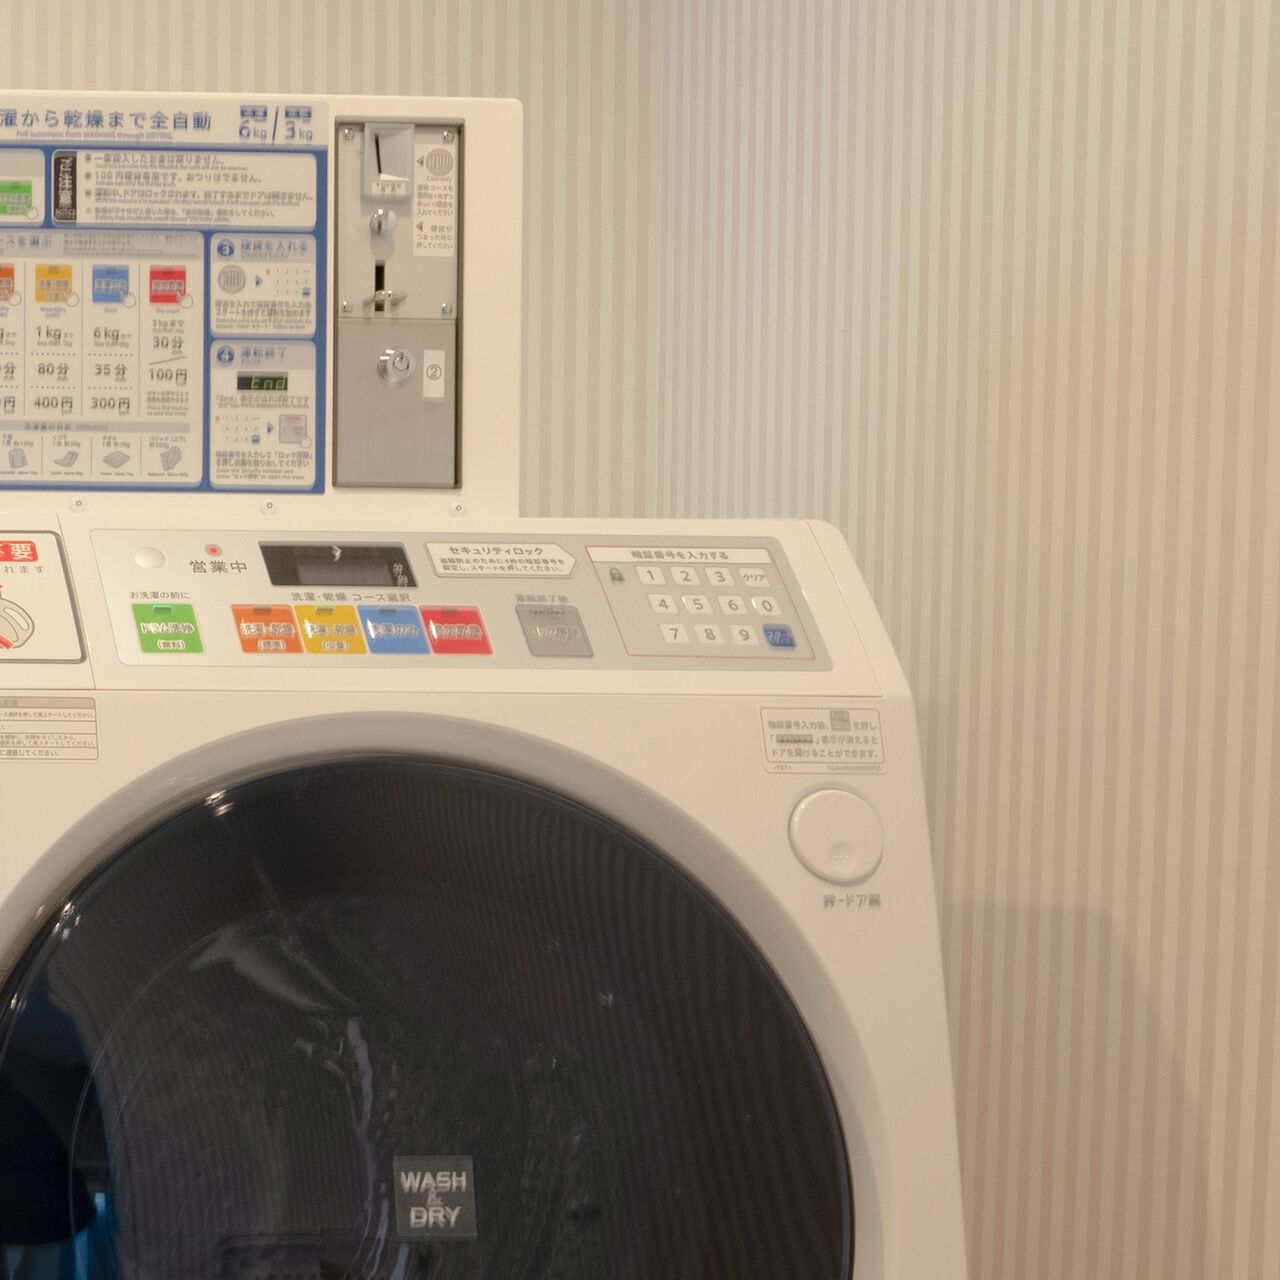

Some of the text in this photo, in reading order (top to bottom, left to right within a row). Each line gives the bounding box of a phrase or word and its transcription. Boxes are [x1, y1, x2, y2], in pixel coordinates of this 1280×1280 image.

[449, 546, 543, 555] セキュリティロック
[190, 560, 247, 574] 営業中
[647, 570, 655, 582] 1
[681, 571, 692, 582] 2
[715, 572, 726, 583] 3
[352, 593, 411, 602] コース選択
[658, 599, 773, 612] 4 5 6 0
[669, 628, 750, 641] 7 8 9
[400, 1171, 466, 1192] WASH
[410, 1206, 461, 1228] DRY
